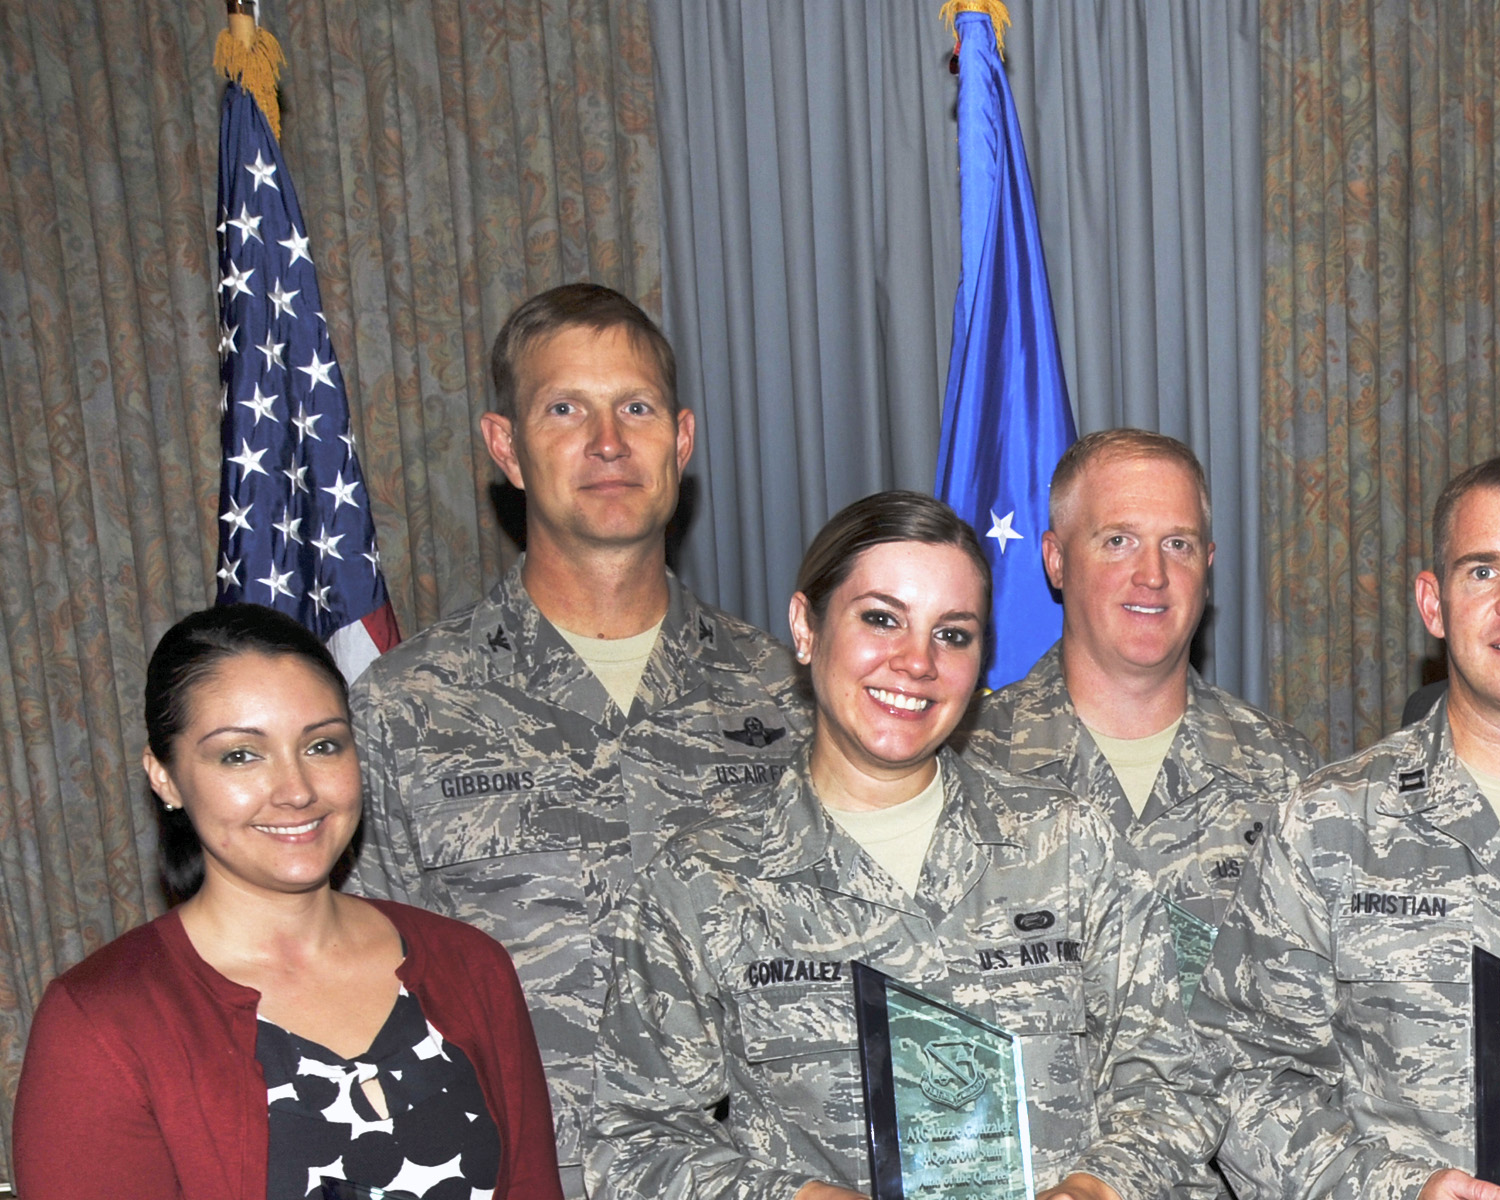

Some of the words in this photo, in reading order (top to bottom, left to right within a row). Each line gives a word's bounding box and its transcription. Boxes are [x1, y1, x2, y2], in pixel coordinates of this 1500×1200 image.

[441, 770, 535, 798] GIBBONS
[744, 764, 767, 783] AIR
[1351, 892, 1447, 917] CHRISTIAN
[979, 950, 1013, 970] U.S.
[1020, 942, 1050, 966] AIR
[748, 958, 842, 987] GONZALEZ
